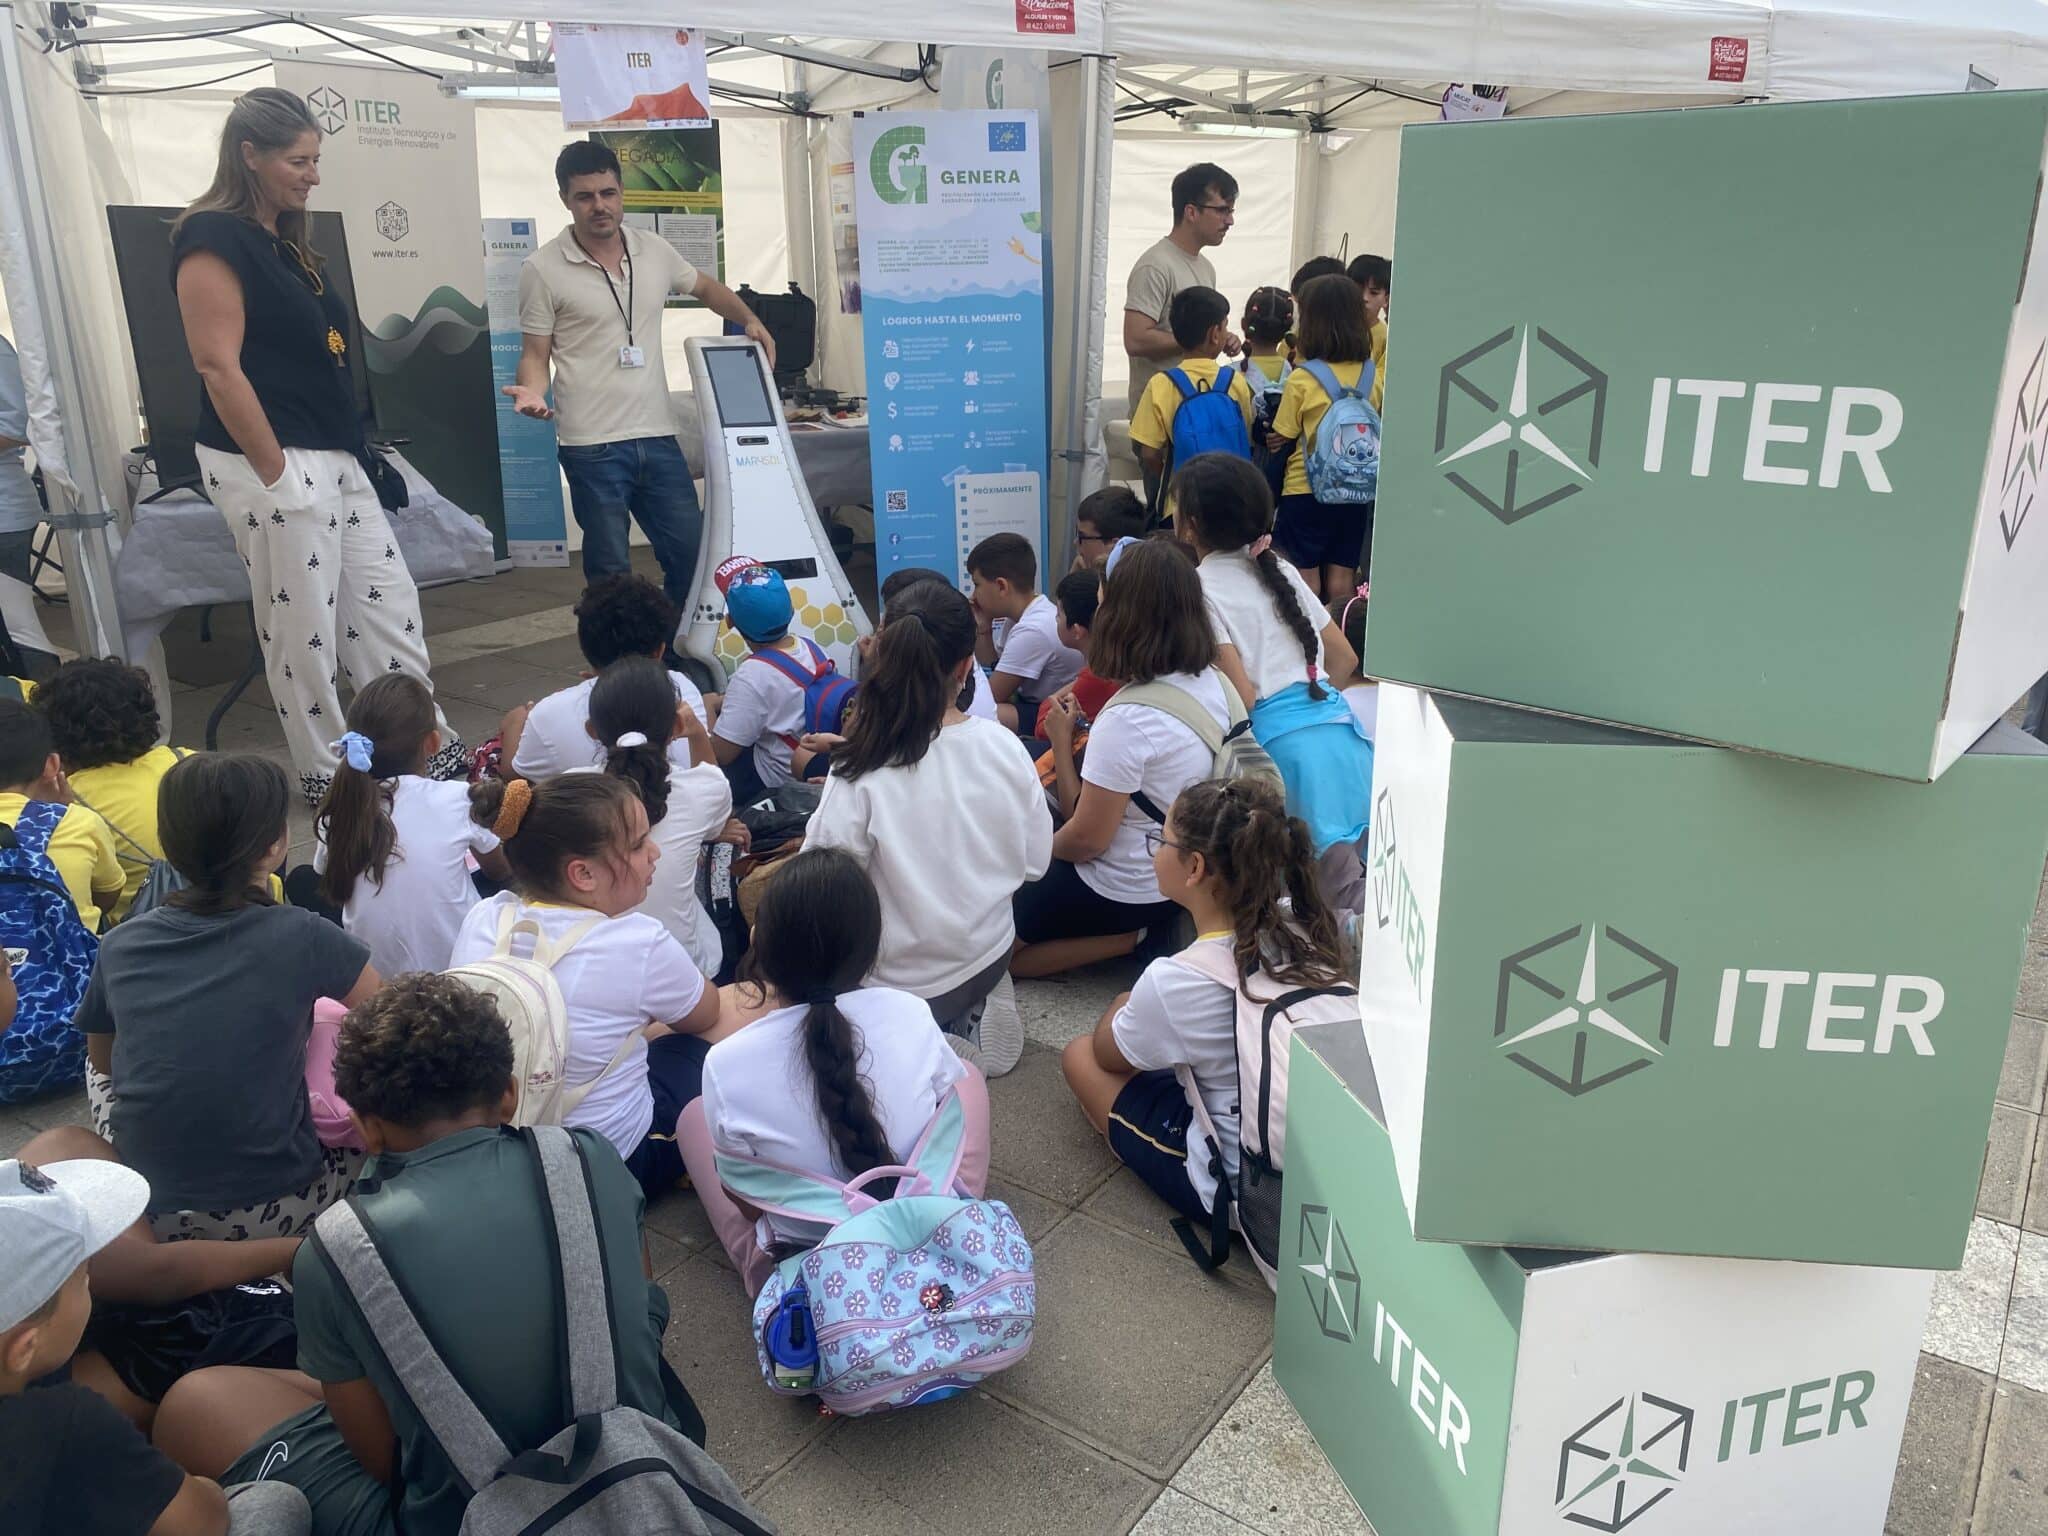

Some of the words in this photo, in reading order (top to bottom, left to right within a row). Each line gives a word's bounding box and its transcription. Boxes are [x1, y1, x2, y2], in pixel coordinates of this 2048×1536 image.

[627, 52, 652, 69] ITER
[355, 99, 401, 125] ITER
[357, 126, 392, 136] Instituto
[447, 131, 457, 140] de
[394, 137, 440, 149] Renovables
[941, 169, 1021, 185] GENERA
[371, 249, 419, 258] www.iter.es
[882, 315, 922, 326] LOGROS
[924, 314, 958, 325] HASTA
[959, 313, 969, 324] EL
[971, 312, 1022, 323] MOMENTO
[1643, 377, 1903, 493] ITER
[973, 485, 1033, 495] PRÓXIMAMENTE
[716, 557, 755, 577] MARVEL
[1395, 859, 1426, 1005] ITER
[1713, 968, 1945, 1056] ITER
[1373, 1300, 1471, 1477] ITER
[1717, 1370, 1875, 1463] ITER
